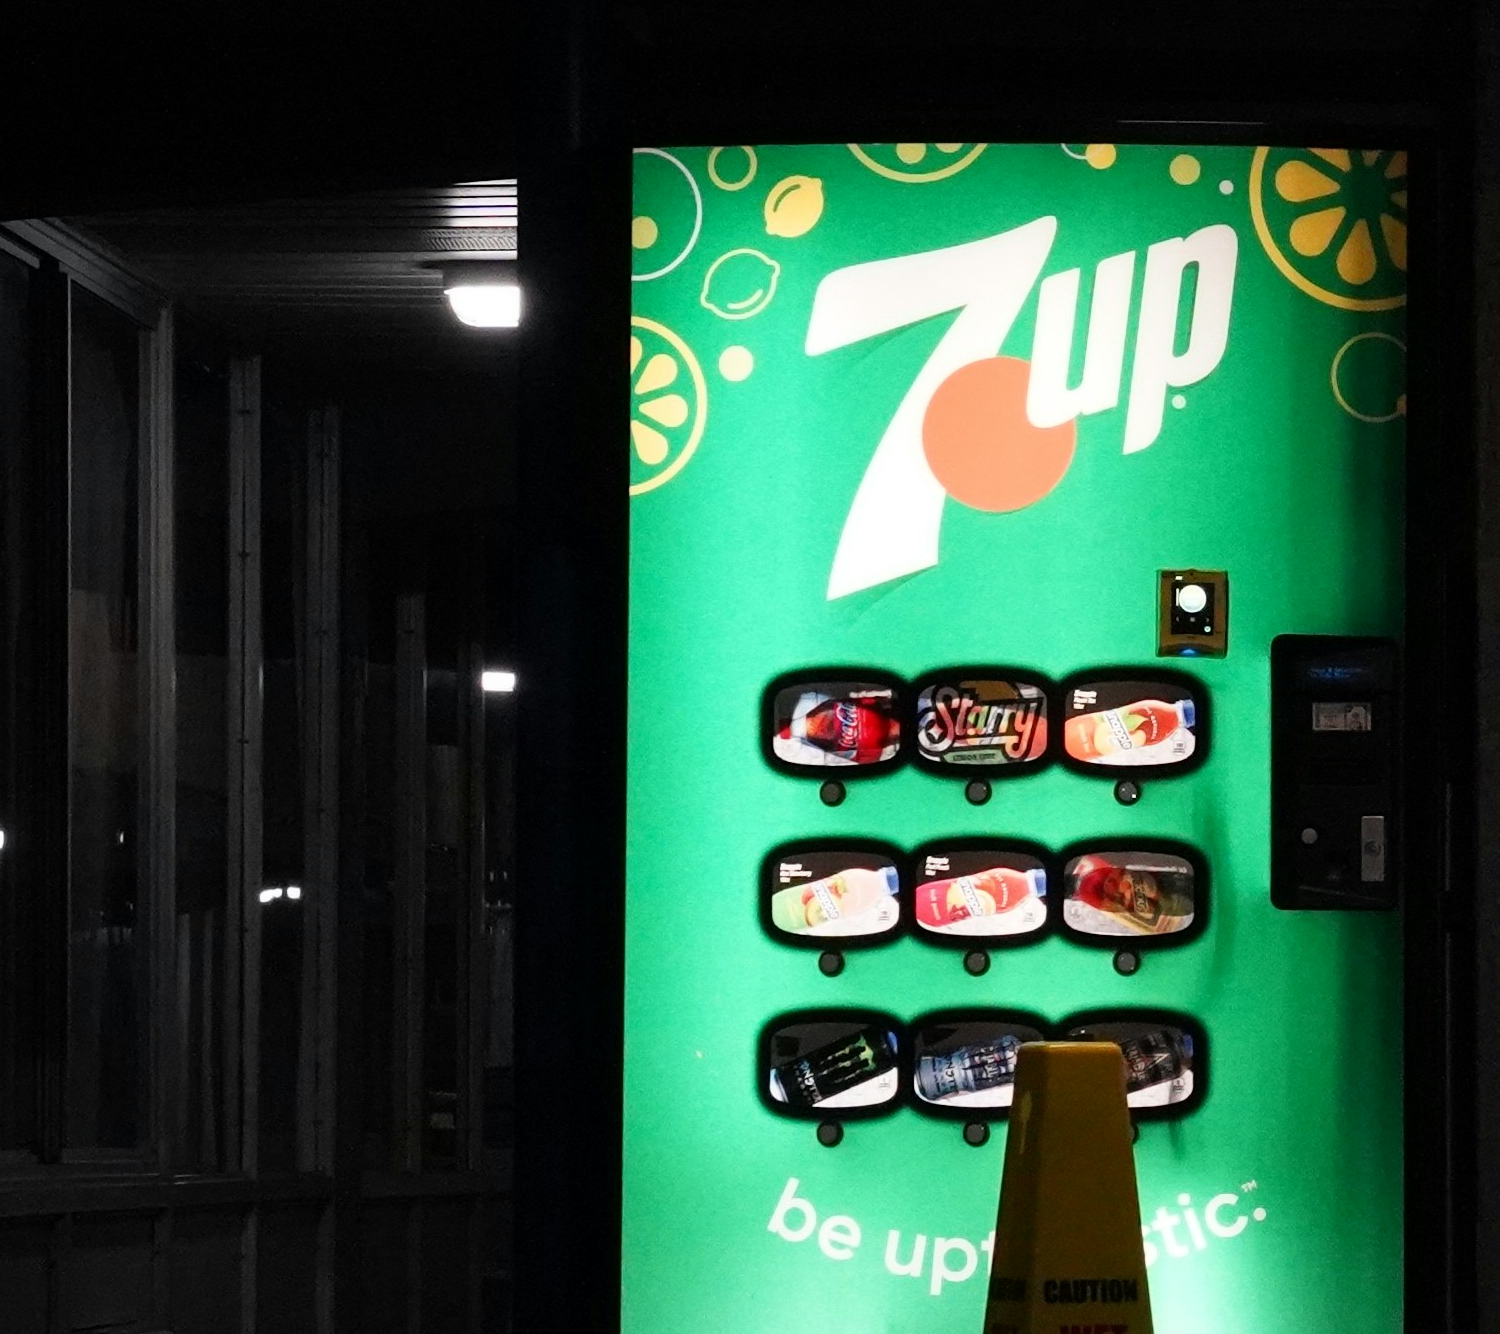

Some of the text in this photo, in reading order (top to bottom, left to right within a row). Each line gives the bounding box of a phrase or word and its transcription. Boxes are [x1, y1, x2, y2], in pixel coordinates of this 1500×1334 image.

[805, 215, 1239, 602] 7up
[917, 687, 1038, 759] Starry
[767, 1177, 862, 1260] be
[1043, 1278, 1138, 1304] CAUTION
